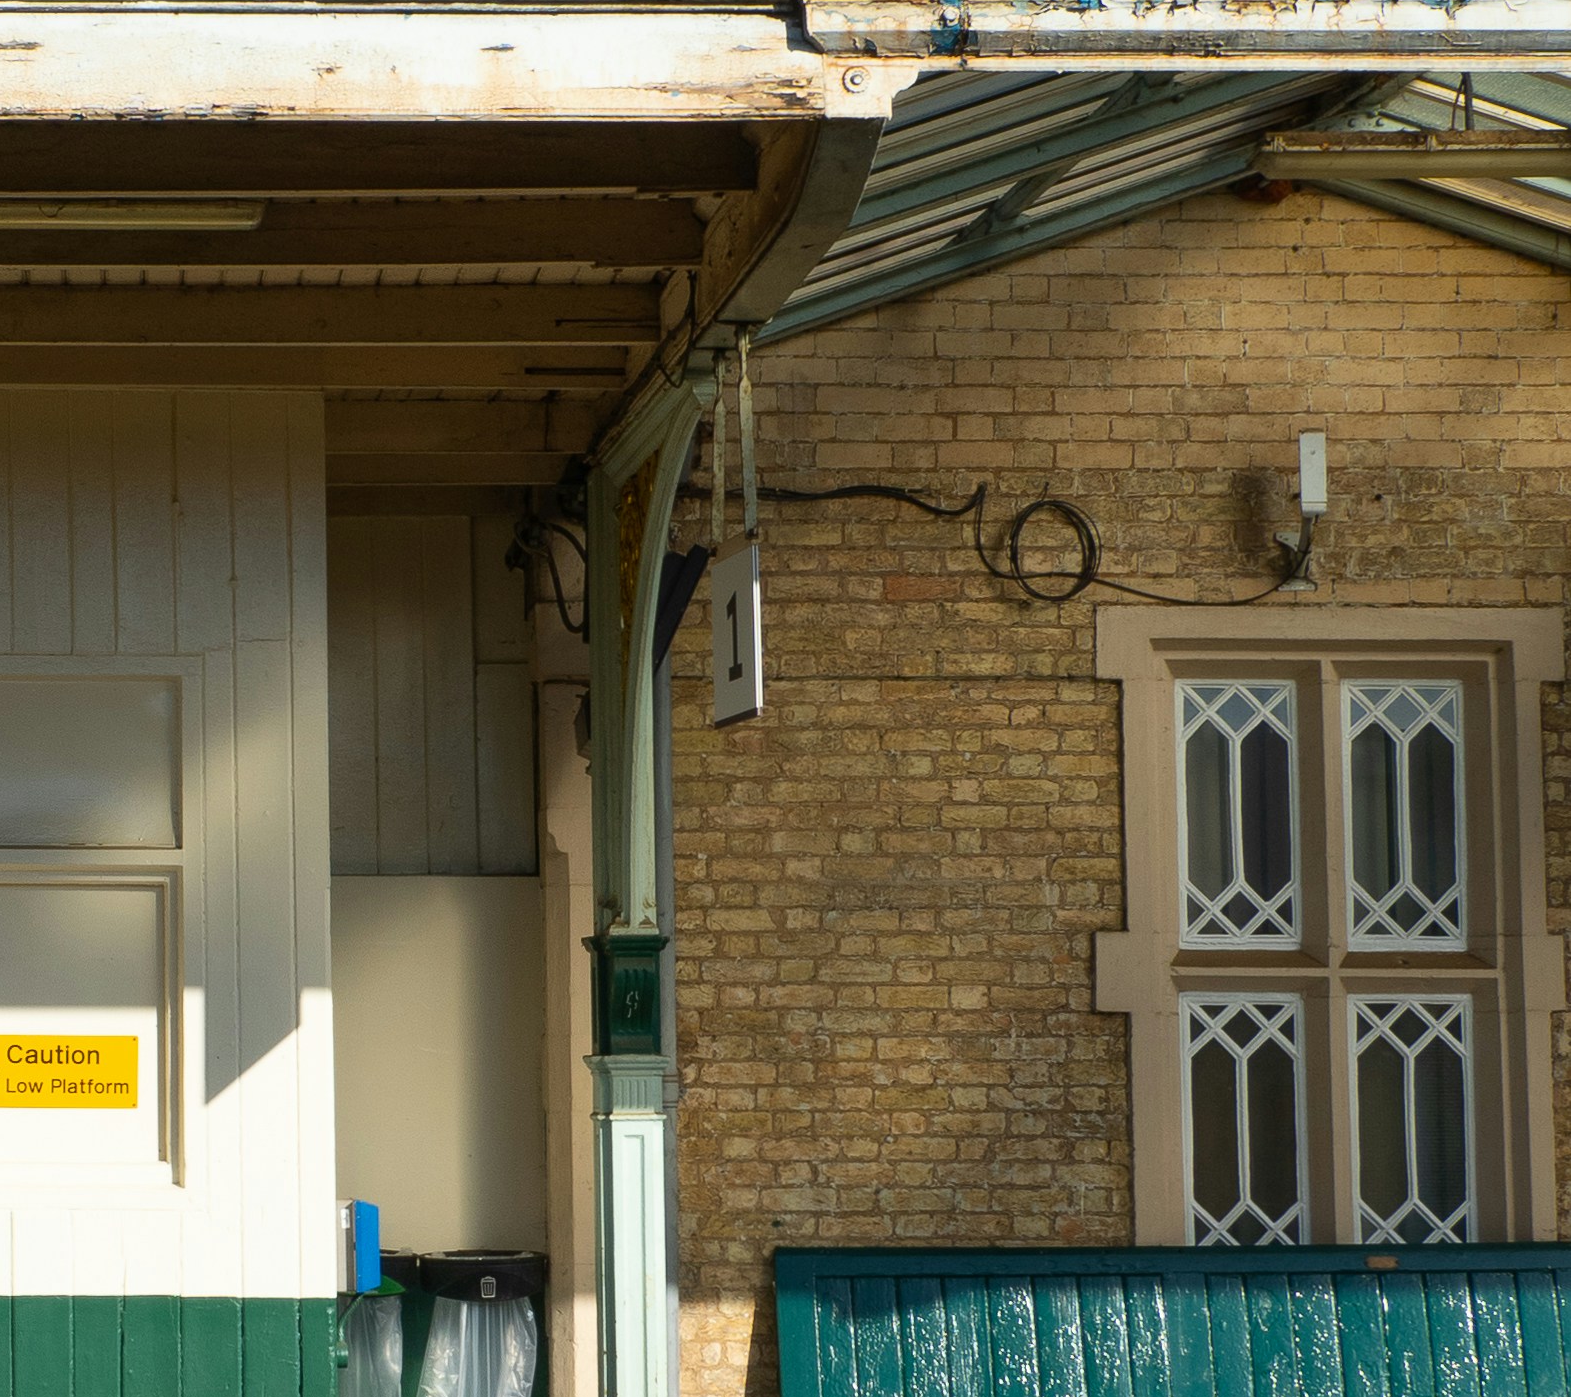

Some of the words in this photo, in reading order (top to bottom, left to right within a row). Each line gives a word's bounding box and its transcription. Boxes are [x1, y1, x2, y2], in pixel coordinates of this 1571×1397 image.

[726, 590, 743, 682] 1
[6, 1044, 100, 1065] Caution
[6, 1078, 44, 1093] Low
[51, 1079, 129, 1094] Platform
